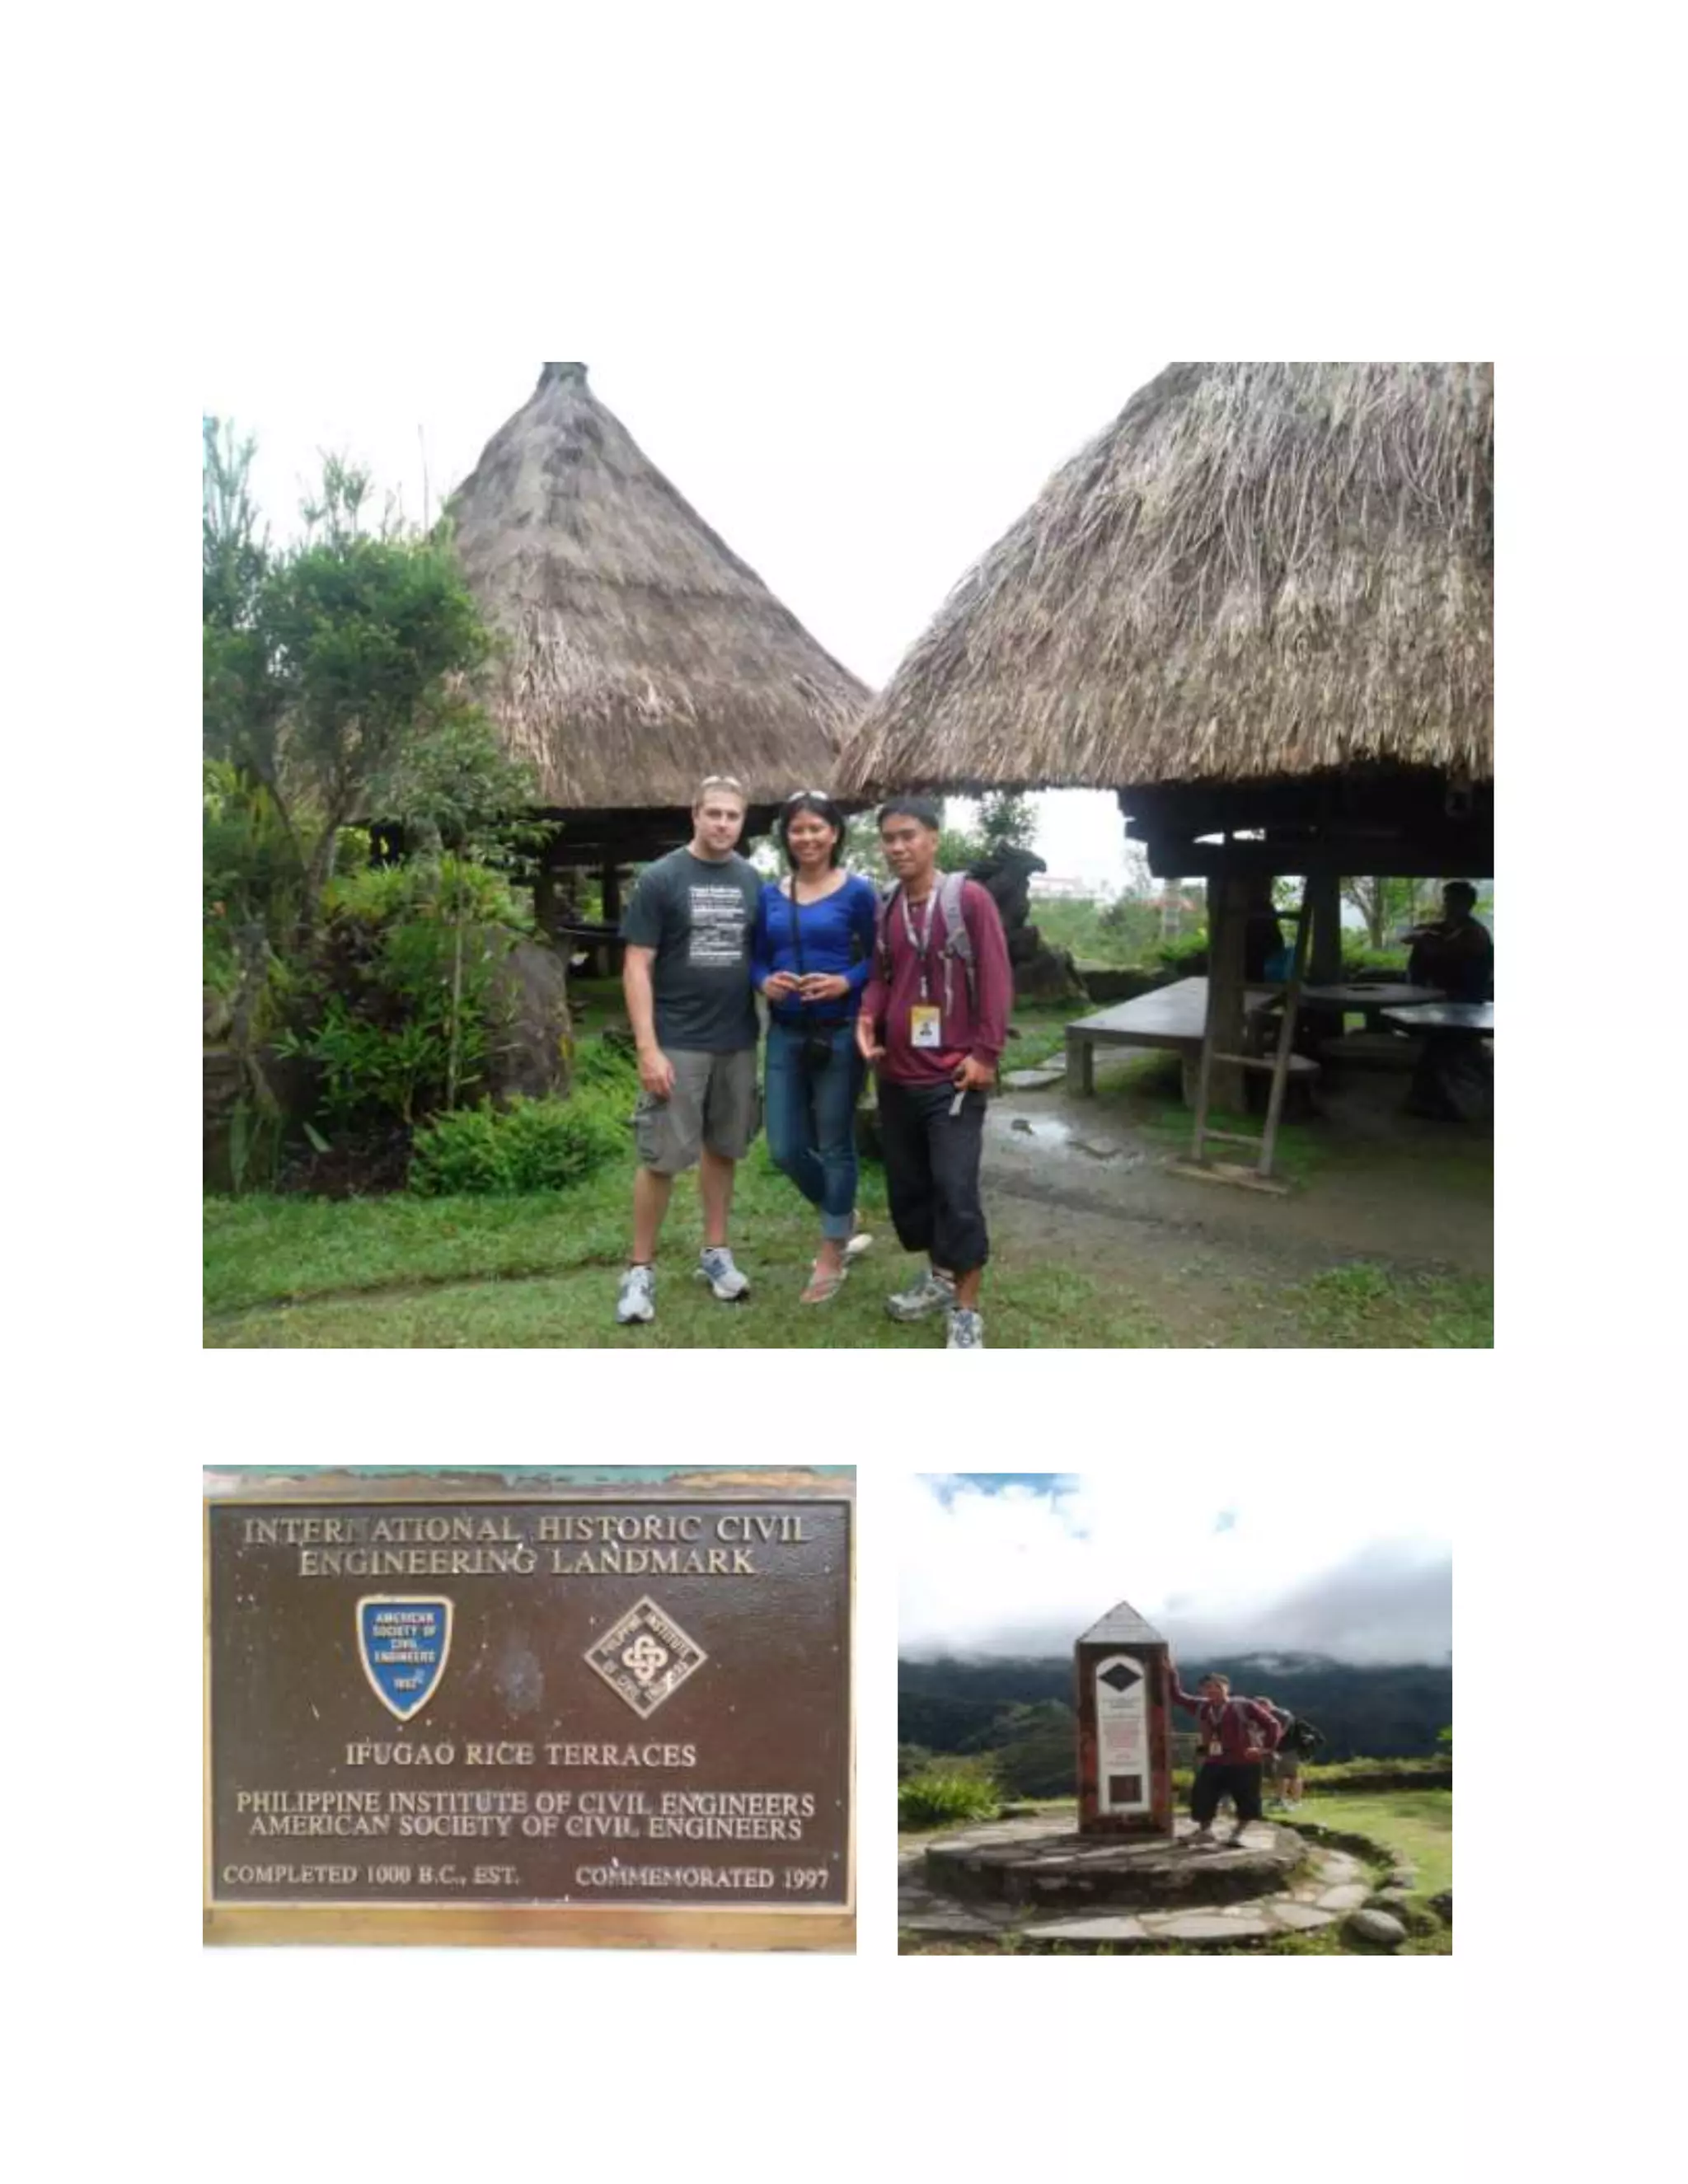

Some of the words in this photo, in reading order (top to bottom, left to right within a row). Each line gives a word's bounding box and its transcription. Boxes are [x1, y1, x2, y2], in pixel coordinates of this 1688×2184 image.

[538, 1515, 701, 1541] HISTORIC
[715, 1515, 811, 1541] CIVIL
[298, 1549, 536, 1577] ENGINEERING
[551, 1548, 757, 1574] LANDMARK
[375, 1612, 435, 1624] AMERICAN
[372, 1624, 417, 1637] SOCIETY
[423, 1625, 437, 1637] OF
[373, 1651, 436, 1663] ENGINEERS
[345, 1741, 455, 1765] IFUGAO
[466, 1741, 534, 1765] RICE
[546, 1743, 697, 1767] TERRACES
[236, 1791, 382, 1813] PHILIPPINE
[388, 1792, 528, 1813] INSTITUTE
[535, 1792, 571, 1814] OF
[578, 1792, 654, 1815] CIVIL
[662, 1792, 816, 1816] ENGINEERS
[249, 1815, 390, 1836] AMERICAN
[399, 1815, 513, 1836] SOCIETY
[521, 1816, 560, 1838] OF
[565, 1816, 640, 1839] CIVIL
[649, 1817, 802, 1840] ENGINEERS
[223, 1864, 358, 1884] COMPLETED
[368, 1865, 411, 1884] 1000
[473, 1866, 520, 1886] EST.
[576, 1866, 775, 1888] COMMEMORATED
[783, 1868, 828, 1889] 1997
